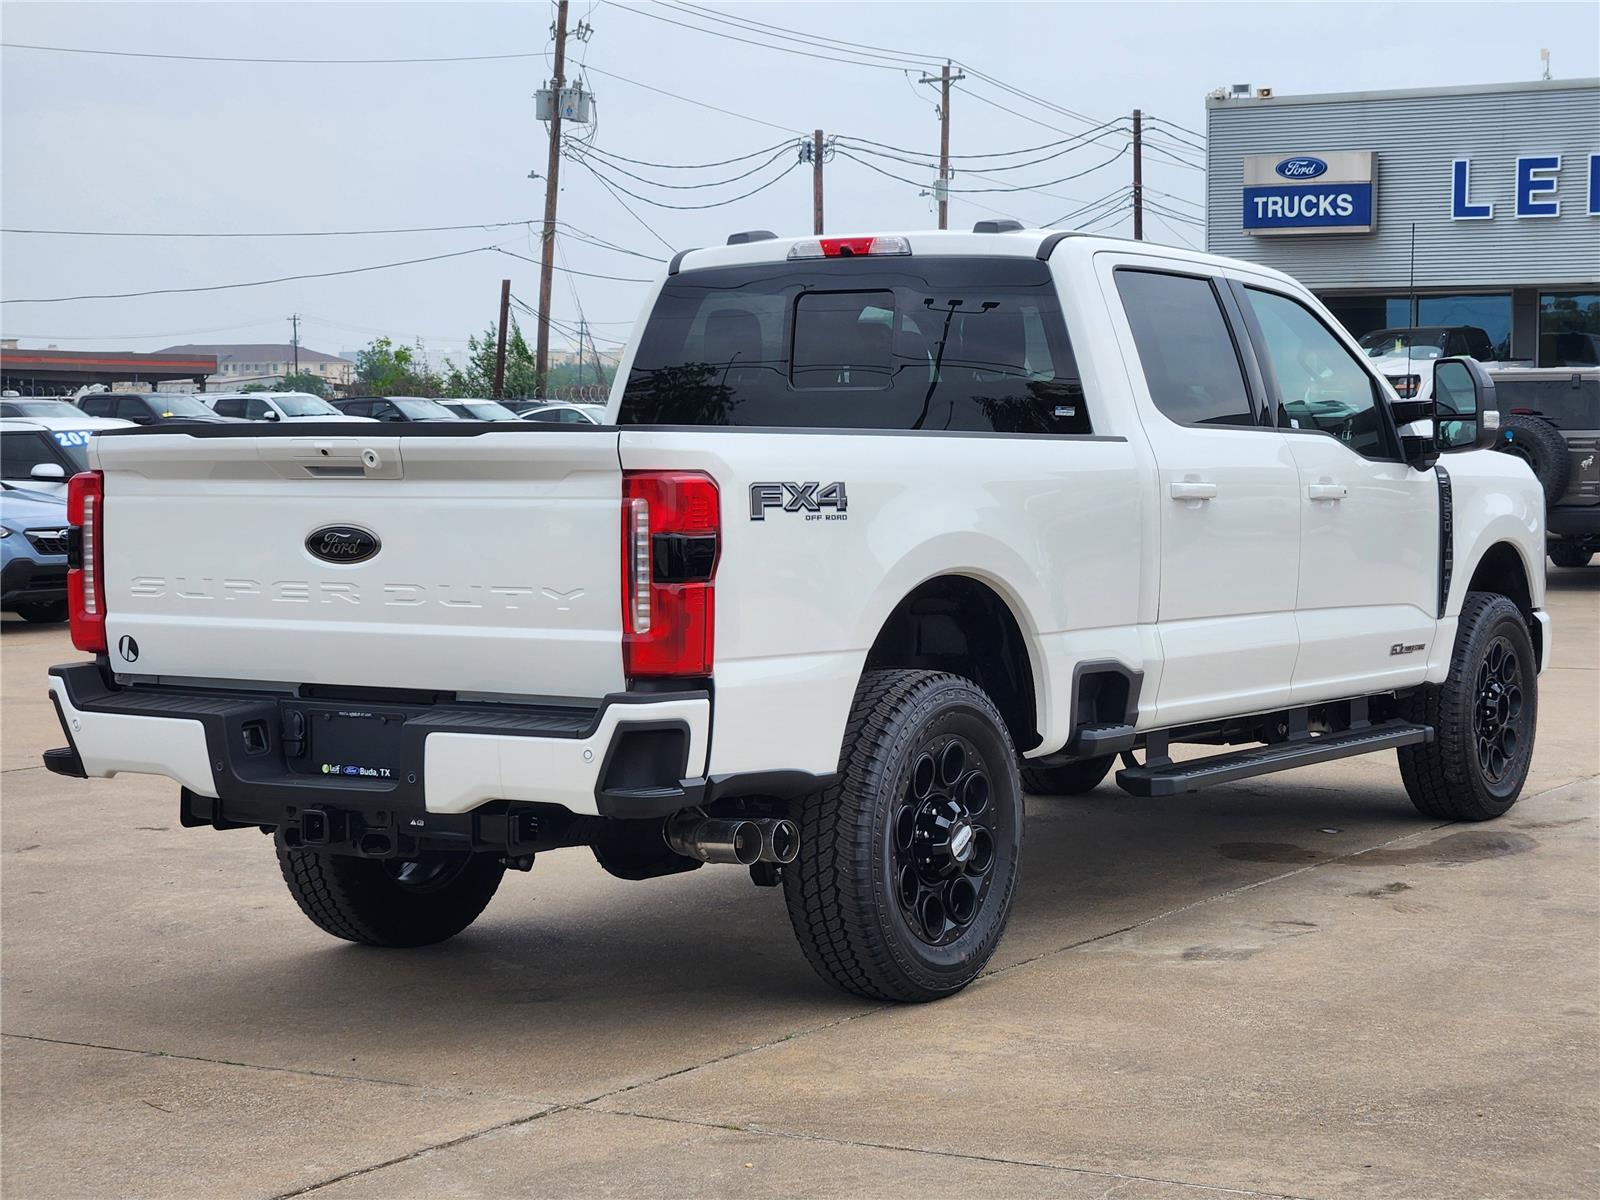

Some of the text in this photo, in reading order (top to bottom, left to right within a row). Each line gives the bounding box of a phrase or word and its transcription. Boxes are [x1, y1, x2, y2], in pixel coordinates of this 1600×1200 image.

[1284, 161, 1317, 176] Ford
[1451, 153, 1600, 221] LE
[1253, 193, 1353, 219] TRUCKS
[748, 482, 848, 521] FX4
[320, 532, 361, 554] Ford
[130, 576, 585, 611] SUPER DUTY
[380, 768, 391, 777] TX
